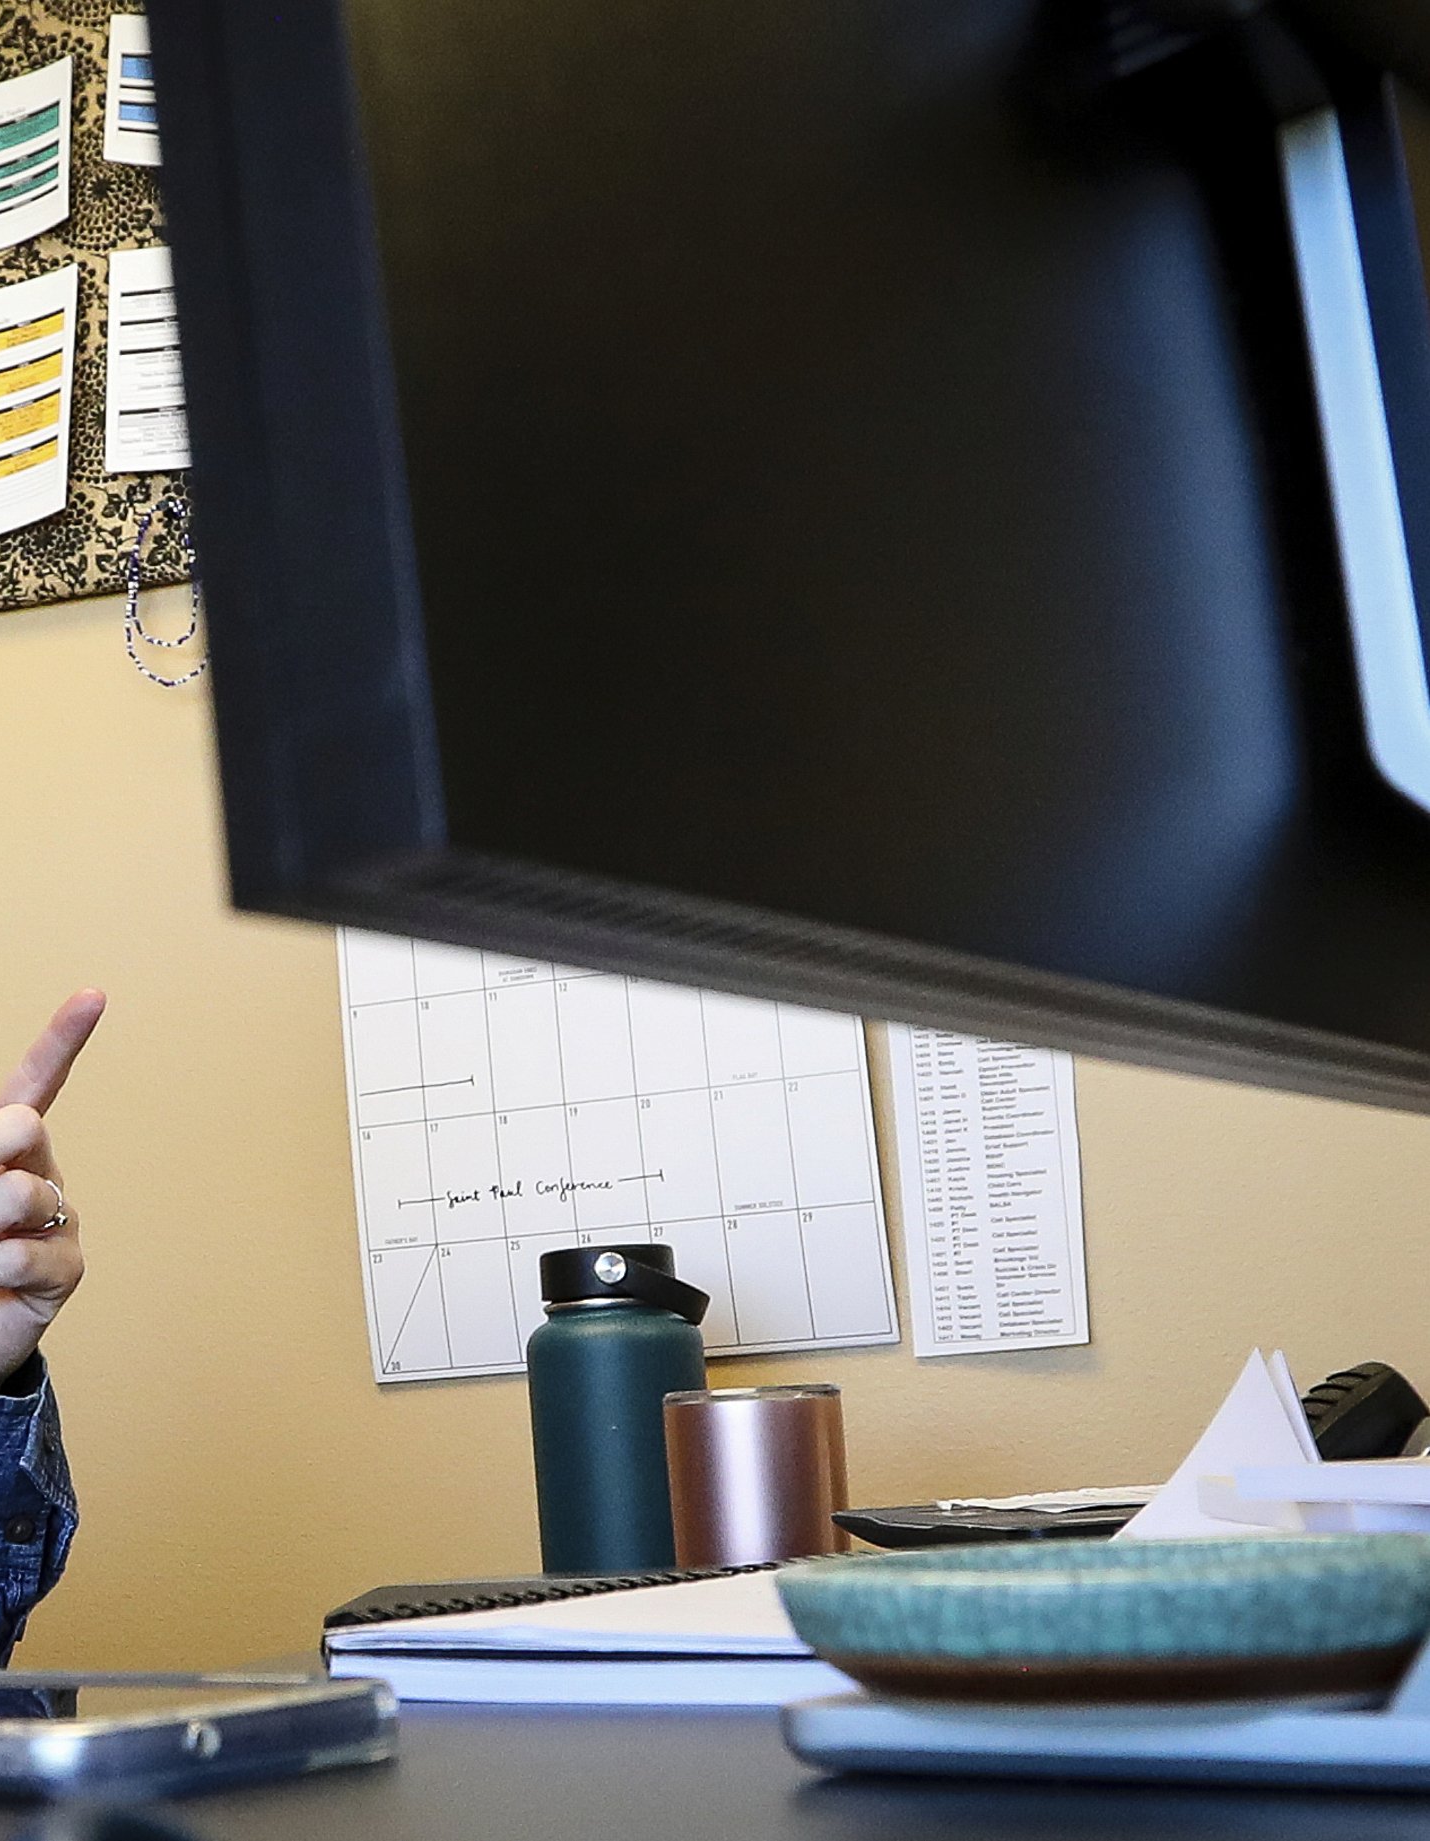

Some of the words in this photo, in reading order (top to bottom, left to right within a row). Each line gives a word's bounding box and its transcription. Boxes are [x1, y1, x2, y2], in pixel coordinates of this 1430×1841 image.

[559, 983, 567, 992] 12
[489, 992, 497, 1001] 11
[420, 1001, 429, 1010] 10
[353, 1010, 357, 1019] 9
[788, 1082, 798, 1092] 22
[714, 1091, 723, 1101] 21
[640, 1099, 651, 1109] 20
[569, 1108, 578, 1117] 19
[499, 1116, 507, 1125] 18
[430, 1124, 439, 1133] 17
[362, 1131, 371, 1140] 16
[446, 1190, 480, 1209] Saint
[489, 1181, 522, 1200] Paul
[536, 1177, 613, 1201] Conference
[734, 1202, 757, 1210] SUMMER
[802, 1212, 812, 1223] 29
[727, 1219, 738, 1230] 28
[653, 1227, 663, 1237] 27
[581, 1233, 591, 1244] 26
[510, 1240, 520, 1251] 25
[441, 1247, 451, 1257] 24
[373, 1254, 383, 1264] 23
[391, 1361, 401, 1371] 30
